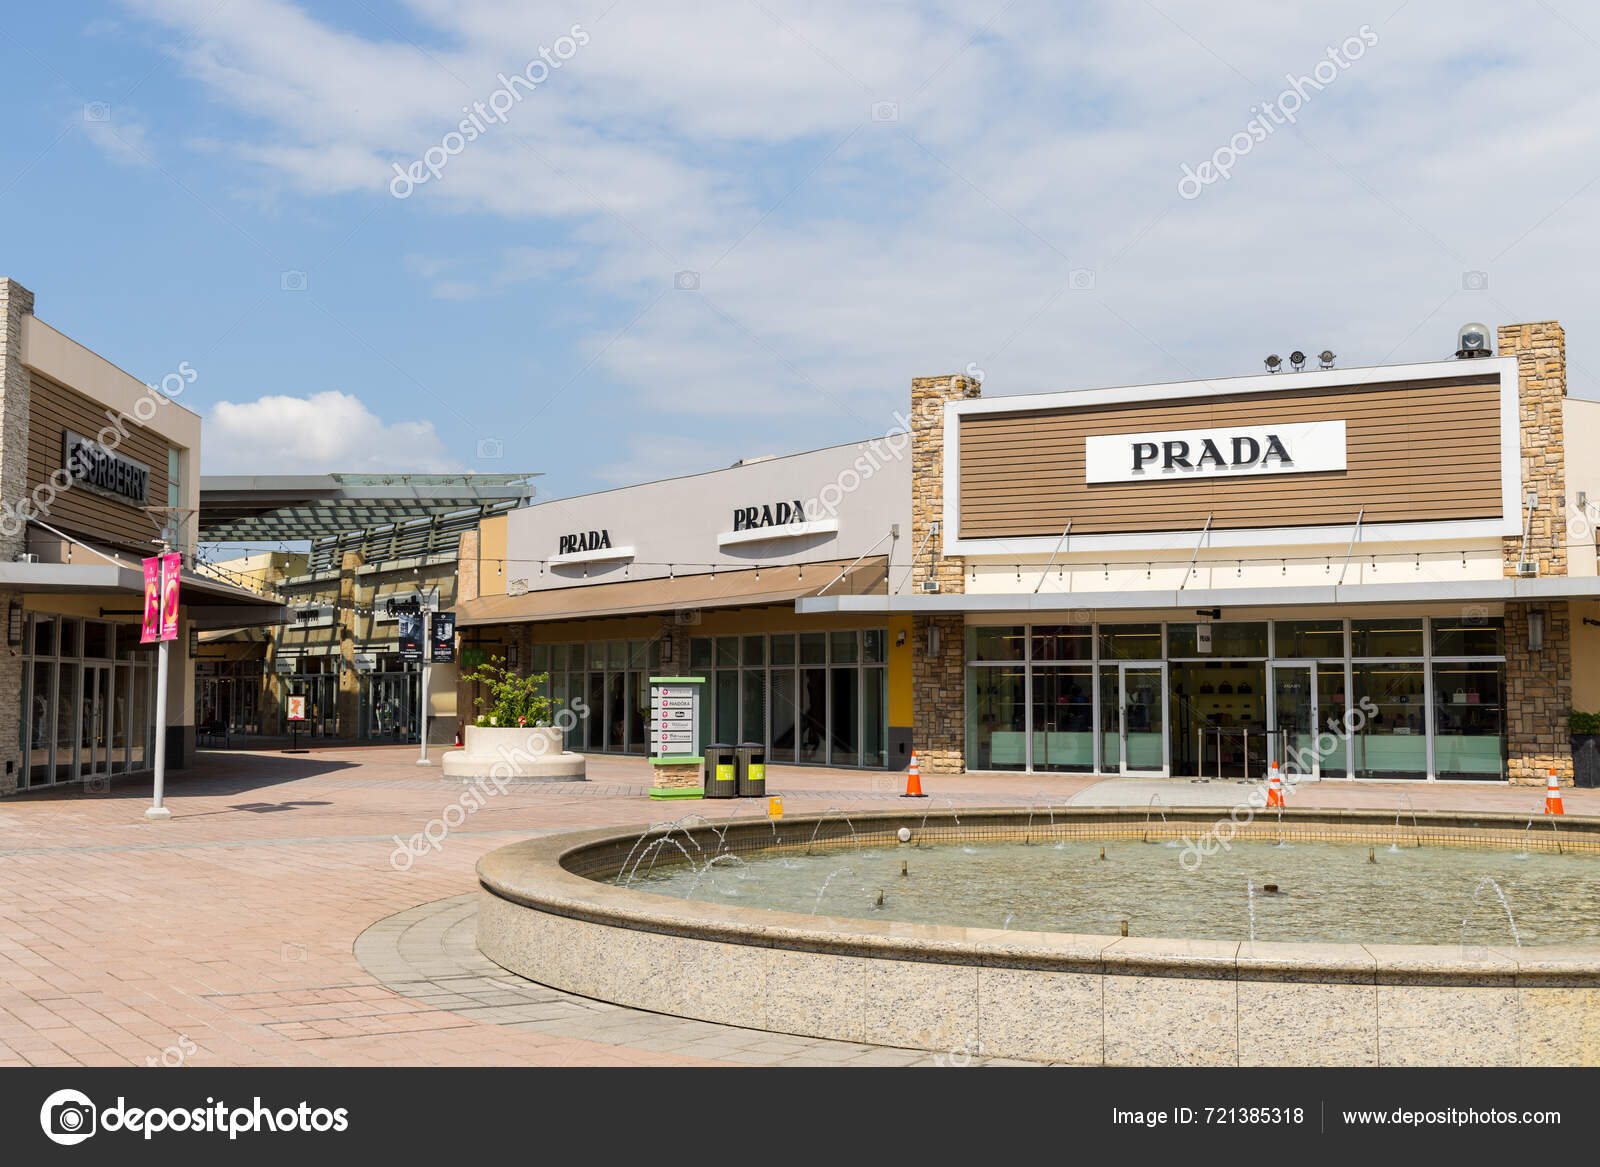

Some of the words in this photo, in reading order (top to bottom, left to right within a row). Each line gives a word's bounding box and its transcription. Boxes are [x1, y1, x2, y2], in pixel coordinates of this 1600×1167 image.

[1130, 434, 1295, 472] PRADA
[733, 500, 807, 532] PRADA
[559, 529, 613, 555] PRADA
